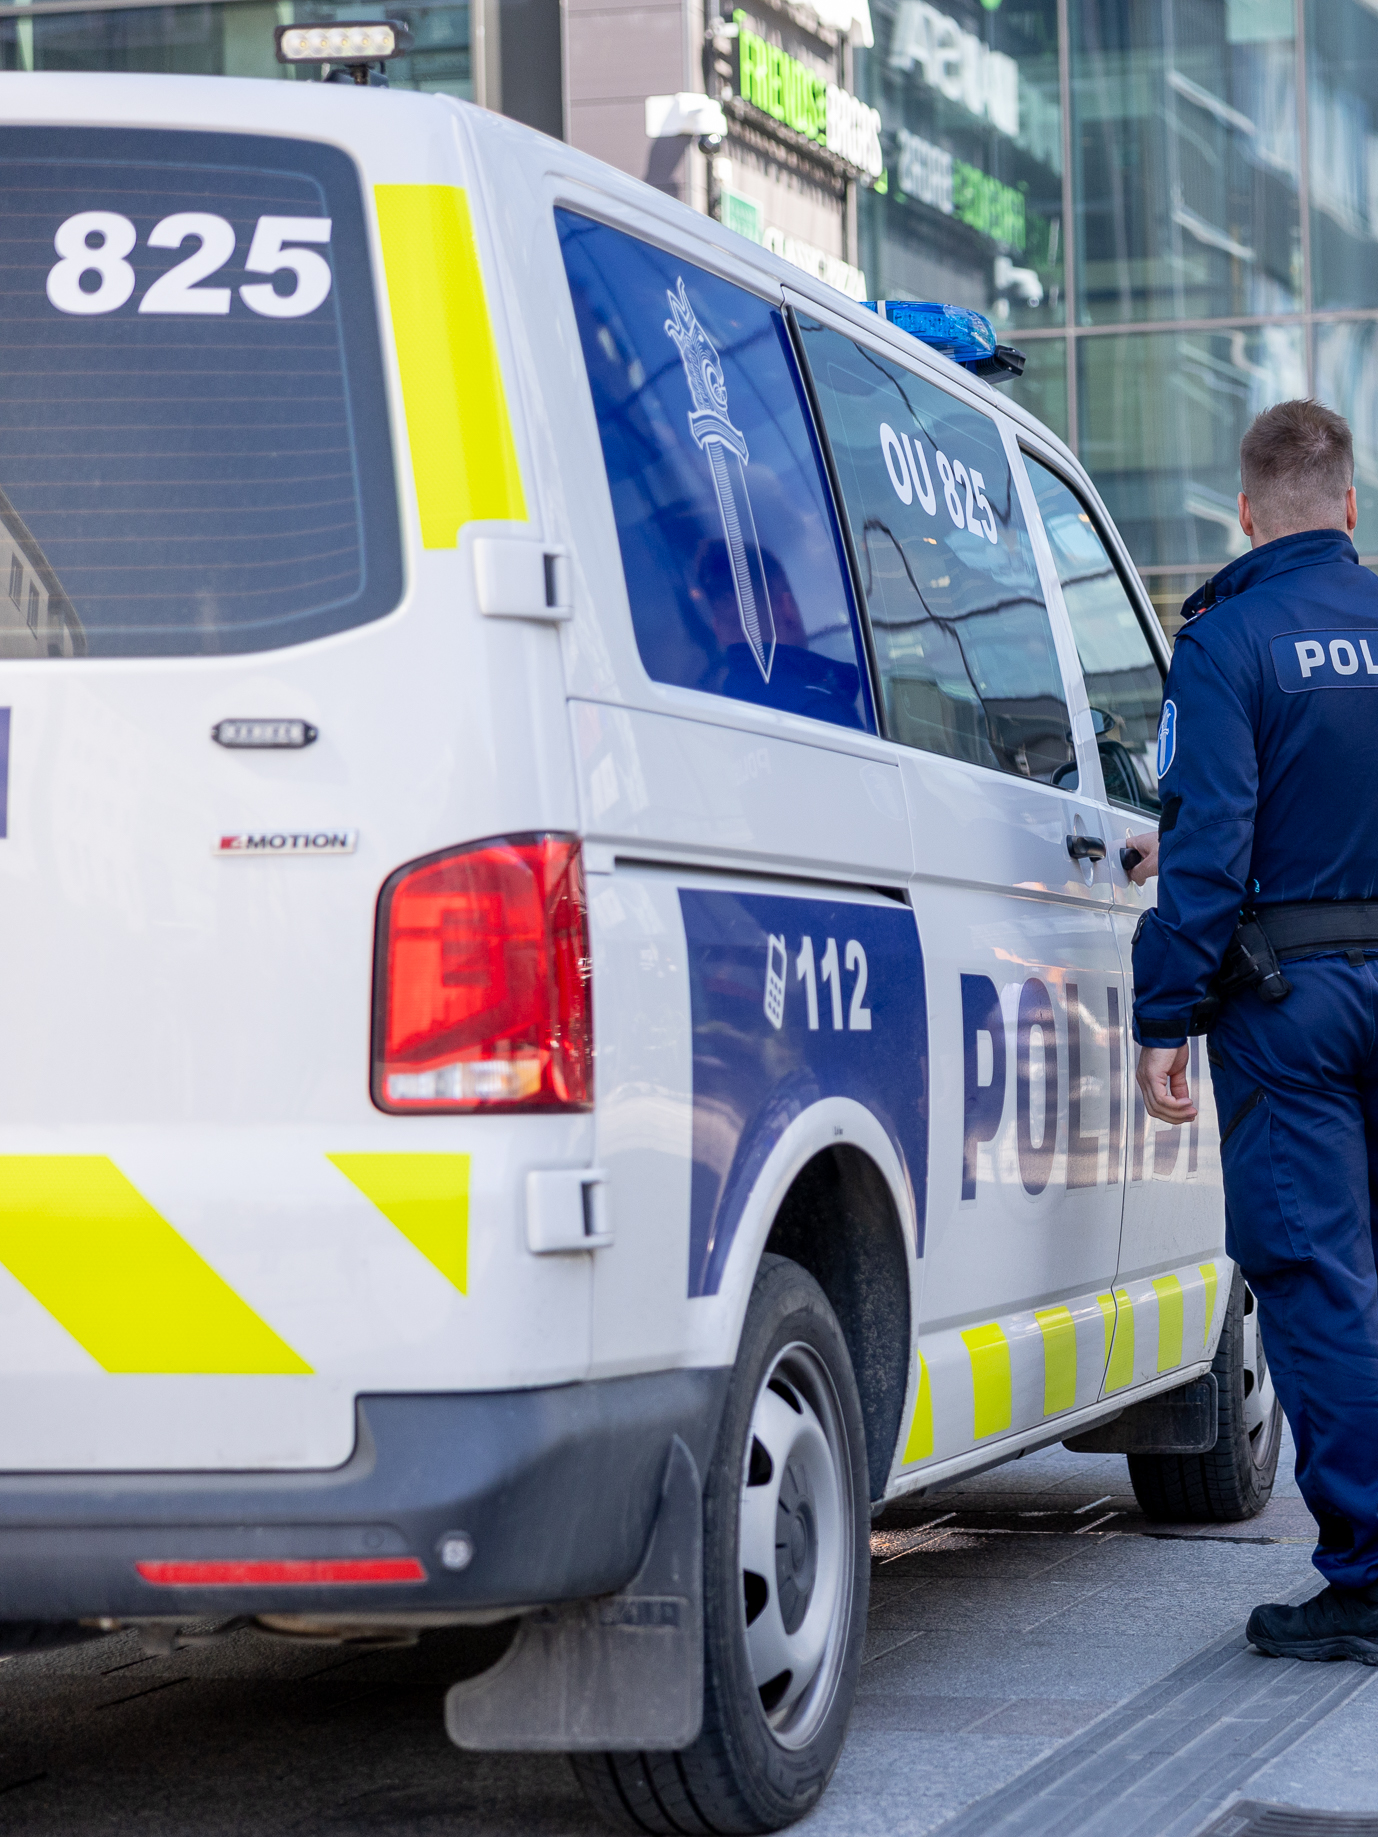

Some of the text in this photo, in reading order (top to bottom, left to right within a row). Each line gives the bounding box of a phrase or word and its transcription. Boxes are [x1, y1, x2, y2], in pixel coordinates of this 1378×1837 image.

[46, 211, 332, 318] 825
[880, 423, 998, 545] OU 825
[796, 935, 872, 1030] 112
